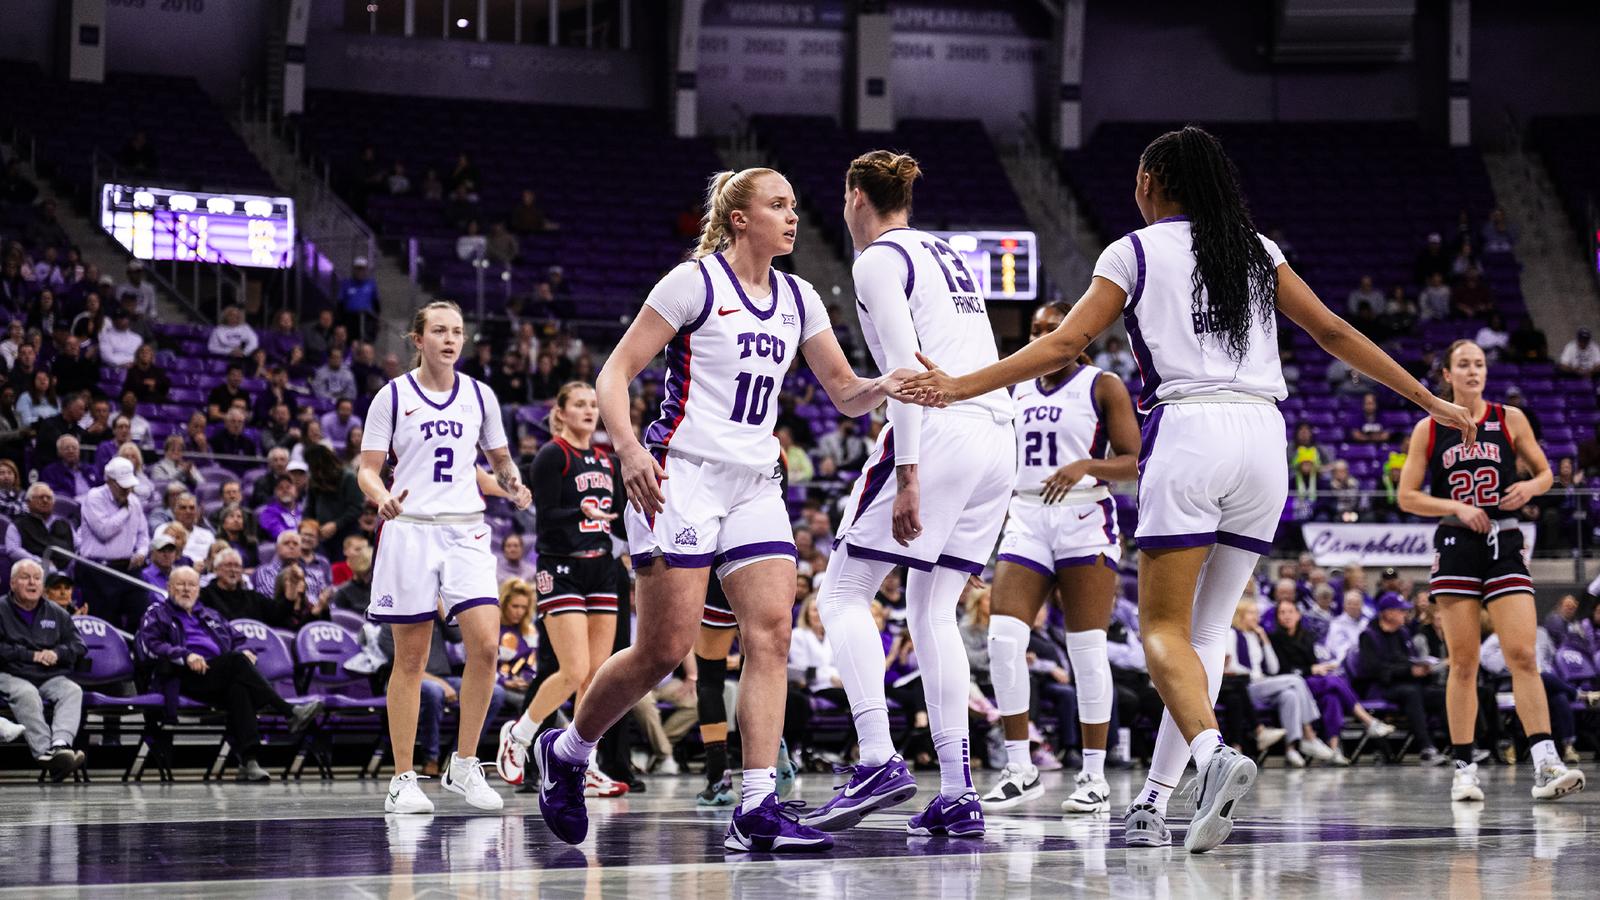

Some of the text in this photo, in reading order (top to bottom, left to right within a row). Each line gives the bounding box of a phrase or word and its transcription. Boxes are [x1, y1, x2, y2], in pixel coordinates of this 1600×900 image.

[920, 241, 976, 293] 13
[952, 296, 985, 314] PRINCE
[737, 332, 786, 365] TCU
[729, 371, 775, 425] 10
[420, 420, 464, 441] TCU
[1023, 406, 1063, 425] TCU
[1025, 431, 1058, 466] 21
[1442, 441, 1502, 469] UTAH
[433, 447, 454, 482] 2
[1448, 466, 1499, 507] 22
[1312, 529, 1427, 558] Campbell's
[309, 626, 343, 643] TCU
